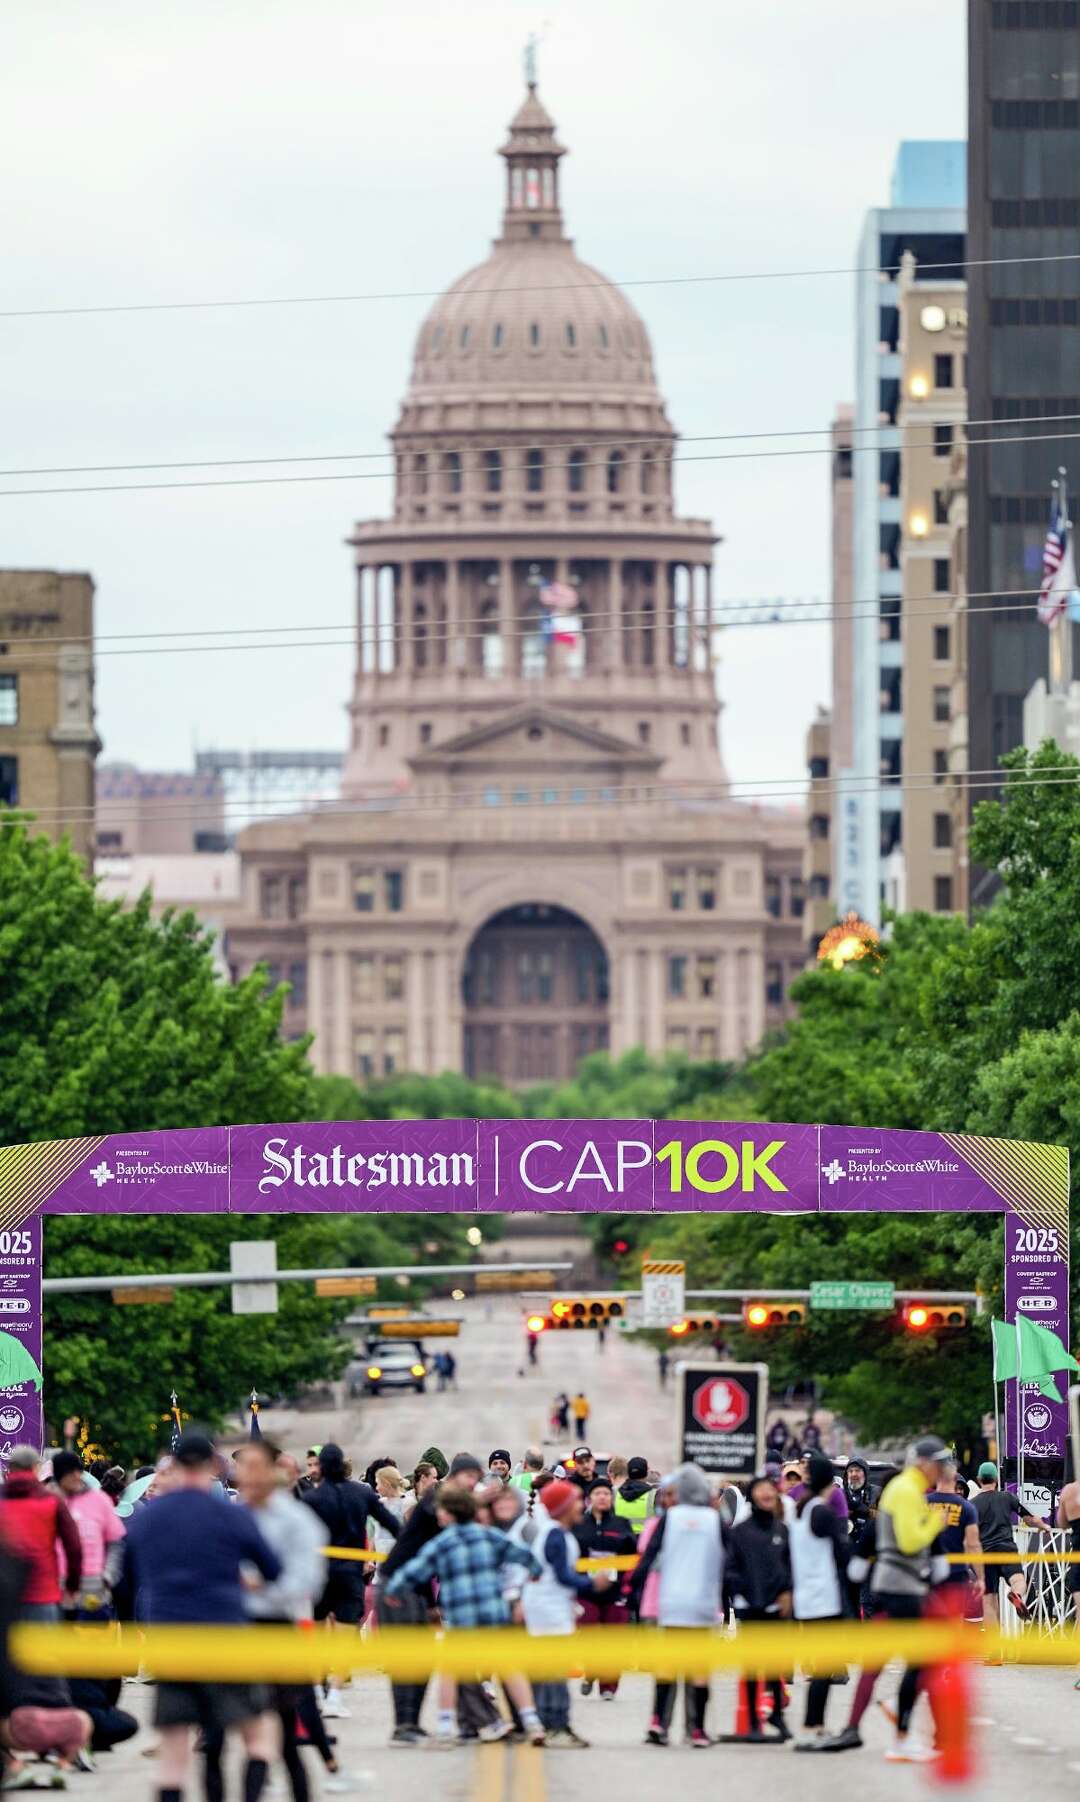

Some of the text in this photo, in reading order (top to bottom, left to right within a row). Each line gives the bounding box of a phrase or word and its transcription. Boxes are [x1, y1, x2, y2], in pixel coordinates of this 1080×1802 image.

[116, 1162, 228, 1177] BaylorScott&White
[258, 1138, 476, 1194] Statesman
[848, 1160, 959, 1175] BaylorScott&White
[1015, 1228, 1058, 1252] 2025
[26, 1257, 36, 1265] BY
[1010, 1254, 1062, 1263] SPONSORED BY
